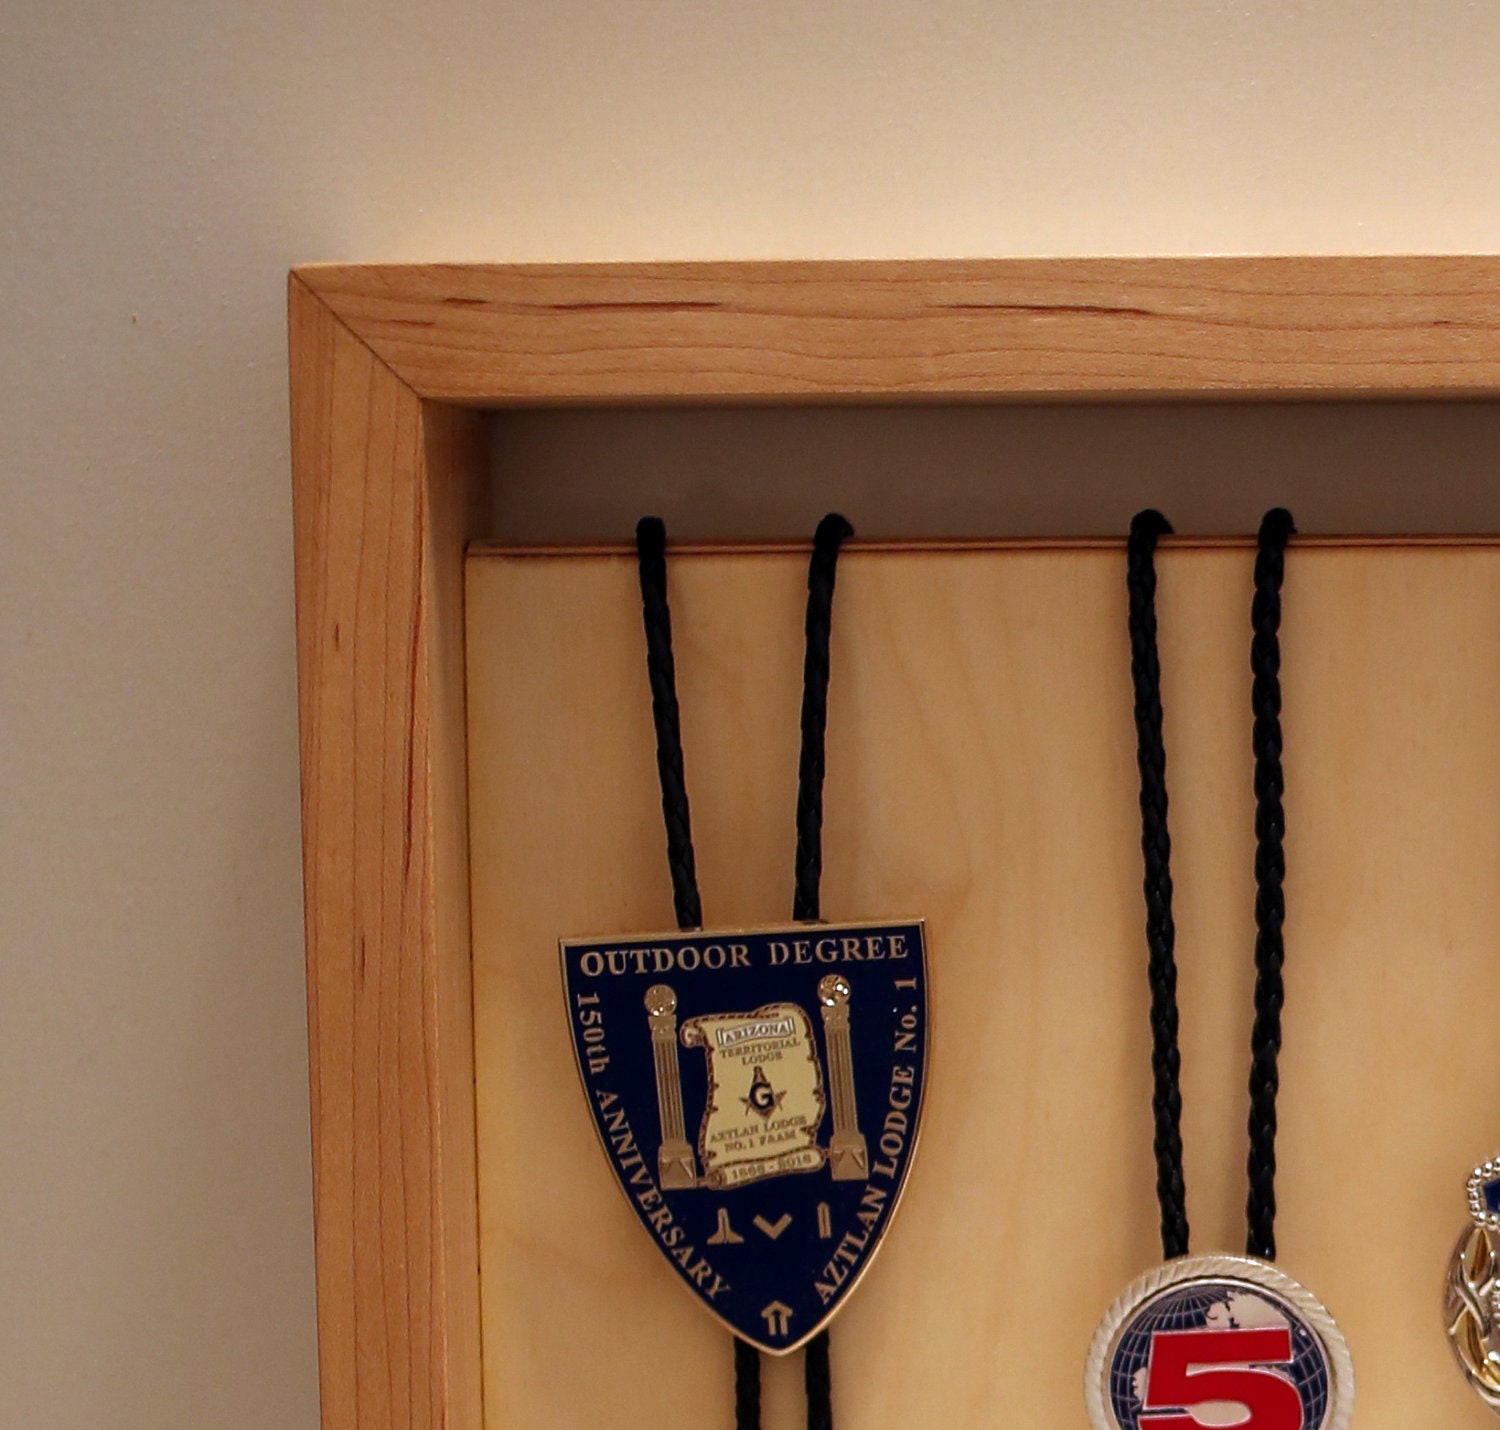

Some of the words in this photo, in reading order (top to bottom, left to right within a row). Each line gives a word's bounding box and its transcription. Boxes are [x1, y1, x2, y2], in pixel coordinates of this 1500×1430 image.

[580, 944, 751, 978] OUTDOOR
[769, 935, 909, 967] DEGREE
[577, 992, 611, 1075] 150th
[719, 1038, 801, 1060] TERRITORIAL
[725, 1022, 788, 1043] ARIZONA
[895, 1004, 918, 1054] No.
[742, 1051, 783, 1066] LODGE
[750, 1082, 775, 1110] G
[879, 1065, 917, 1181] LODGE
[595, 1089, 731, 1299] ANNIVERSARY
[814, 1184, 888, 1304] AZTLAN
